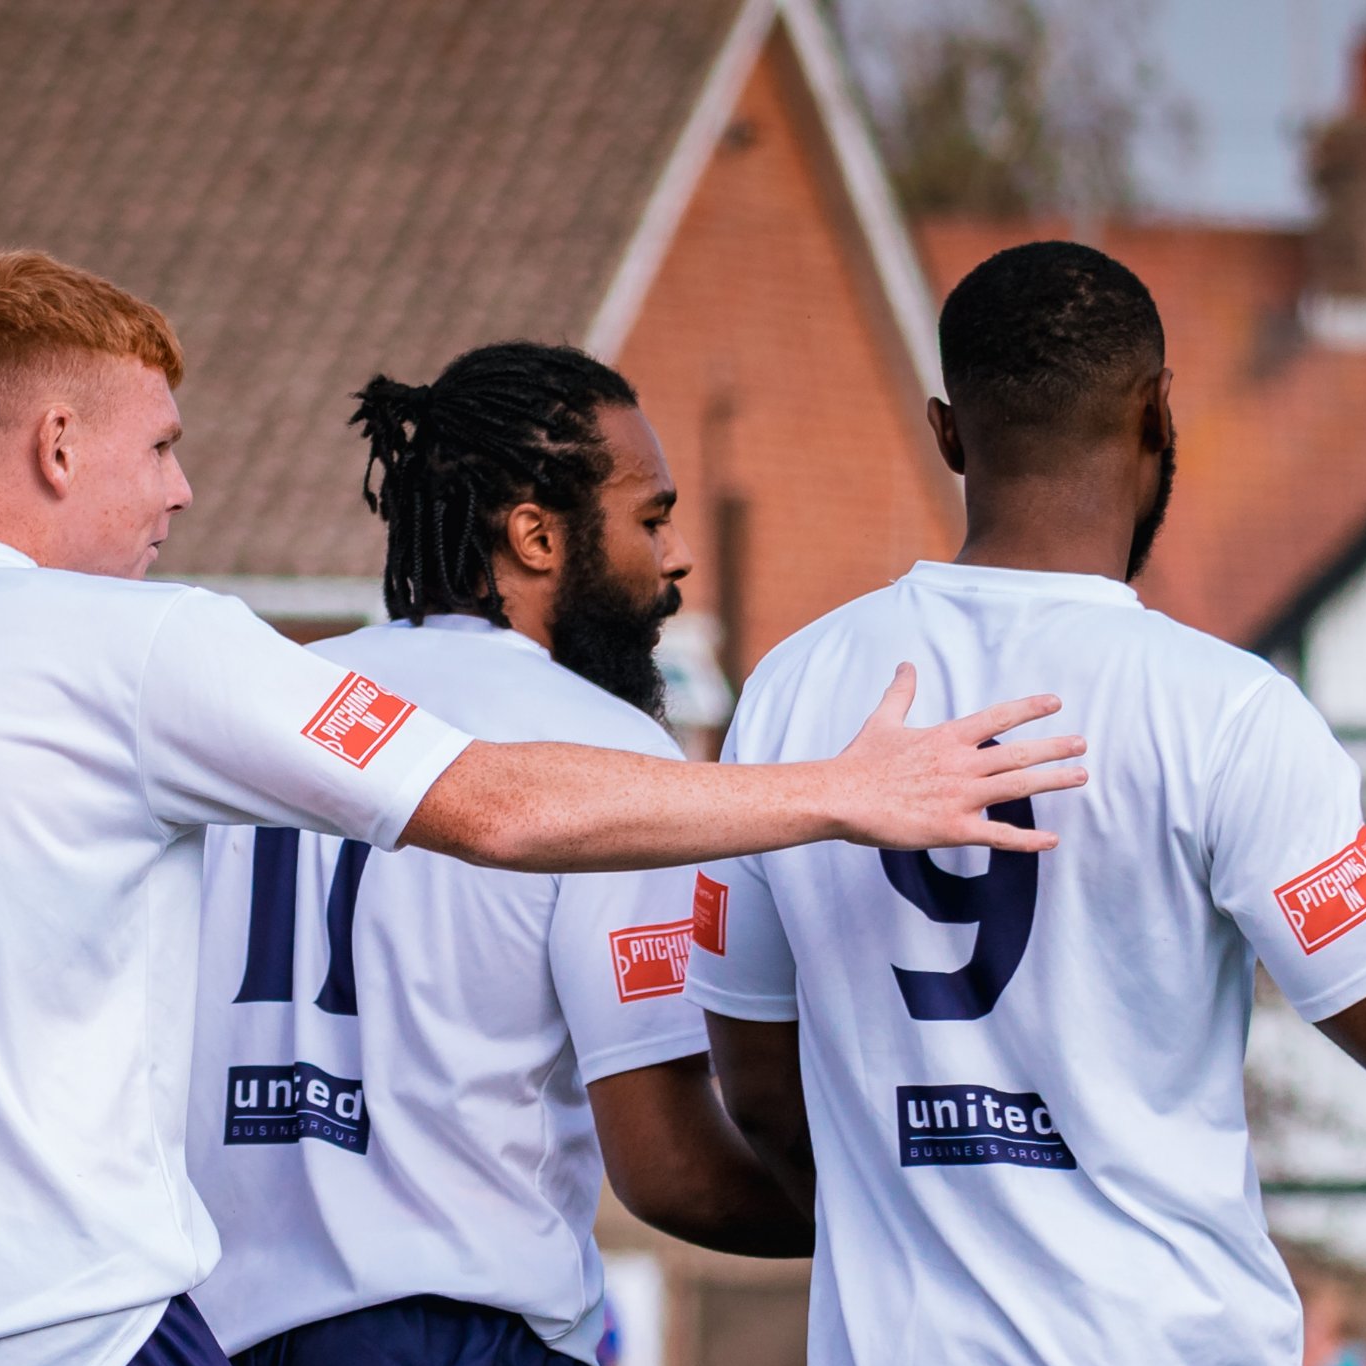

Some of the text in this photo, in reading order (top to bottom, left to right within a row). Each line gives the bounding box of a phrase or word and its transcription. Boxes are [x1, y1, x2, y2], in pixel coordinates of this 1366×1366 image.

[320, 680, 379, 741] PITCHING
[878, 738, 1040, 1021] 9
[1296, 857, 1366, 913] PITCHING
[629, 930, 693, 963] PITCHIN
[234, 1074, 364, 1121] uned
[907, 1092, 1061, 1135] united
[232, 1125, 298, 1137] BUSINE
[910, 1144, 1065, 1162] BUSINESS GROUP
